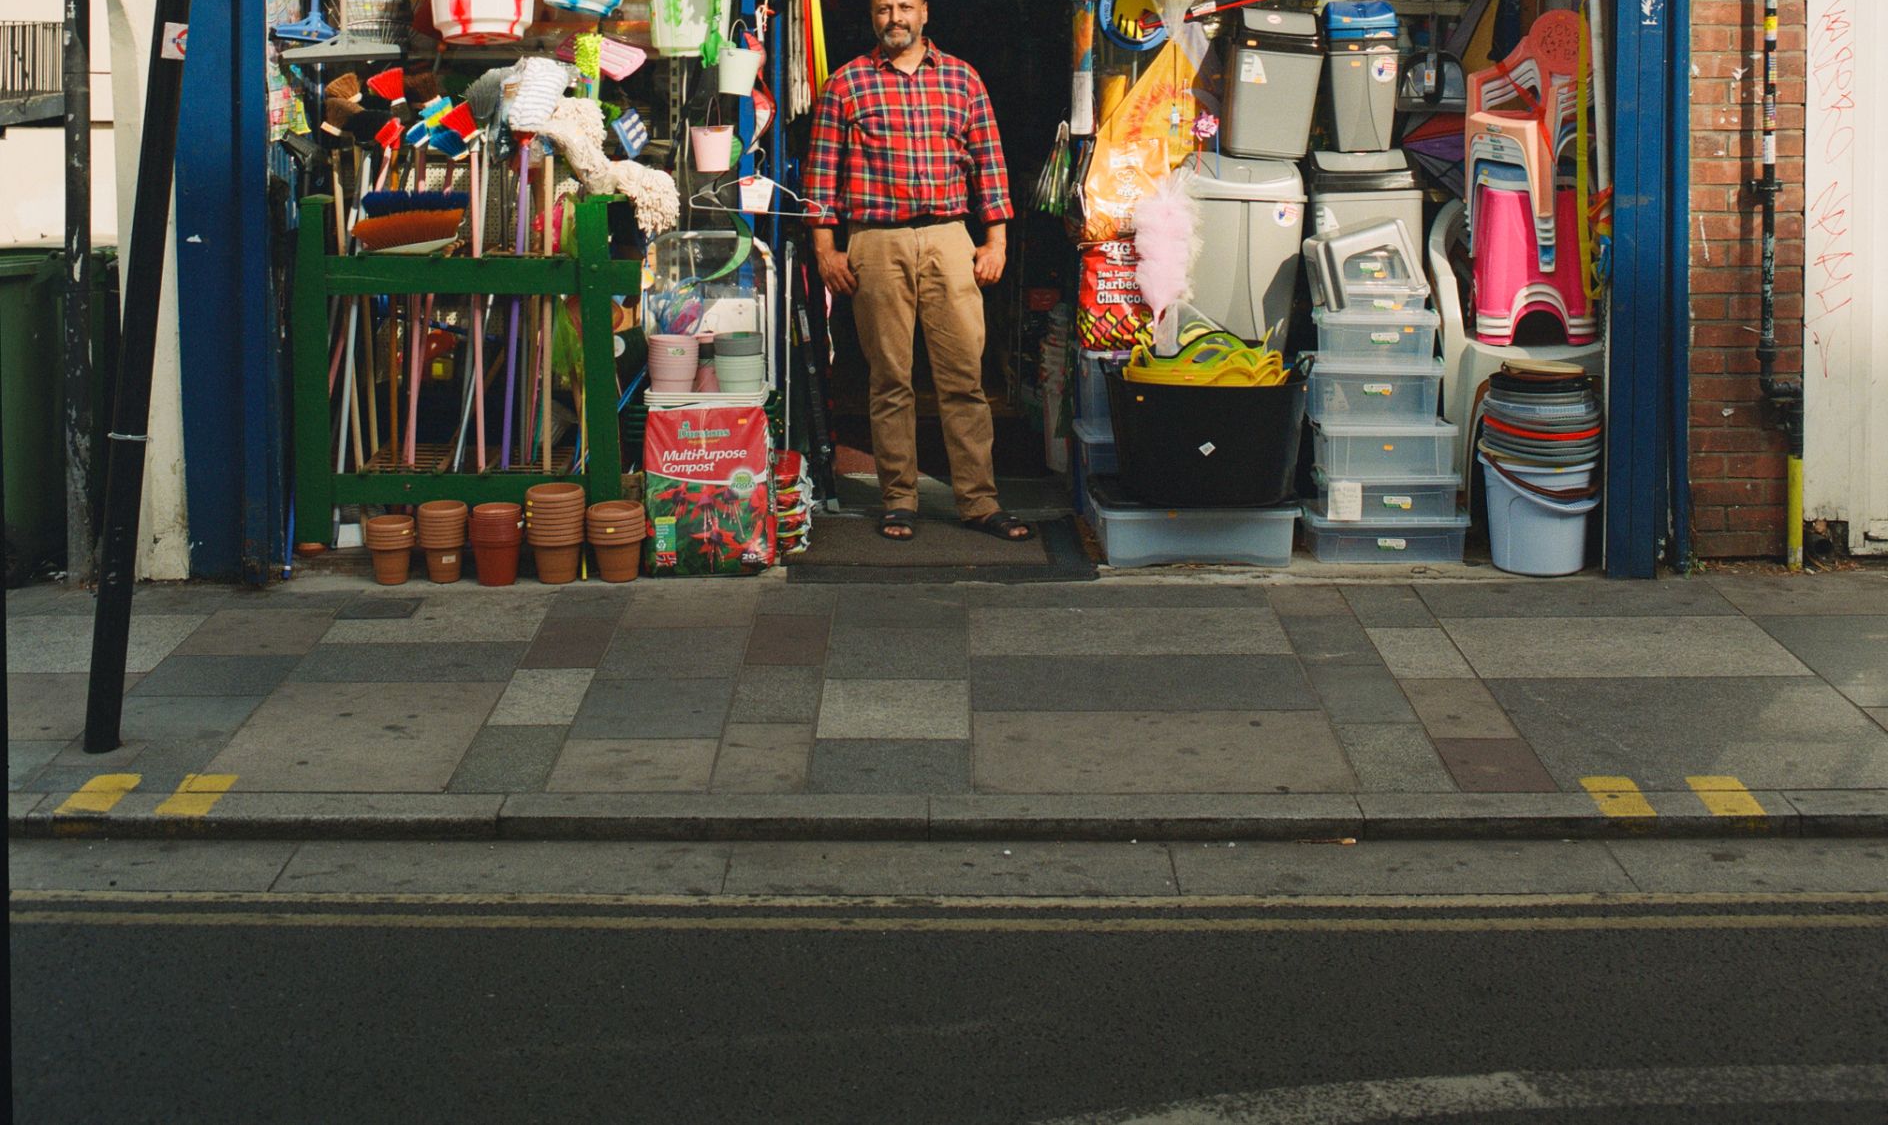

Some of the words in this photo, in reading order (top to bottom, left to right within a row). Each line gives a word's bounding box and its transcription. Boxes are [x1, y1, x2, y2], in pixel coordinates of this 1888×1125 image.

[1097, 279, 1139, 291] Barbec
[1097, 291, 1145, 304] Charco
[662, 448, 748, 463] Multi-Purpose
[662, 462, 716, 475] Compost
